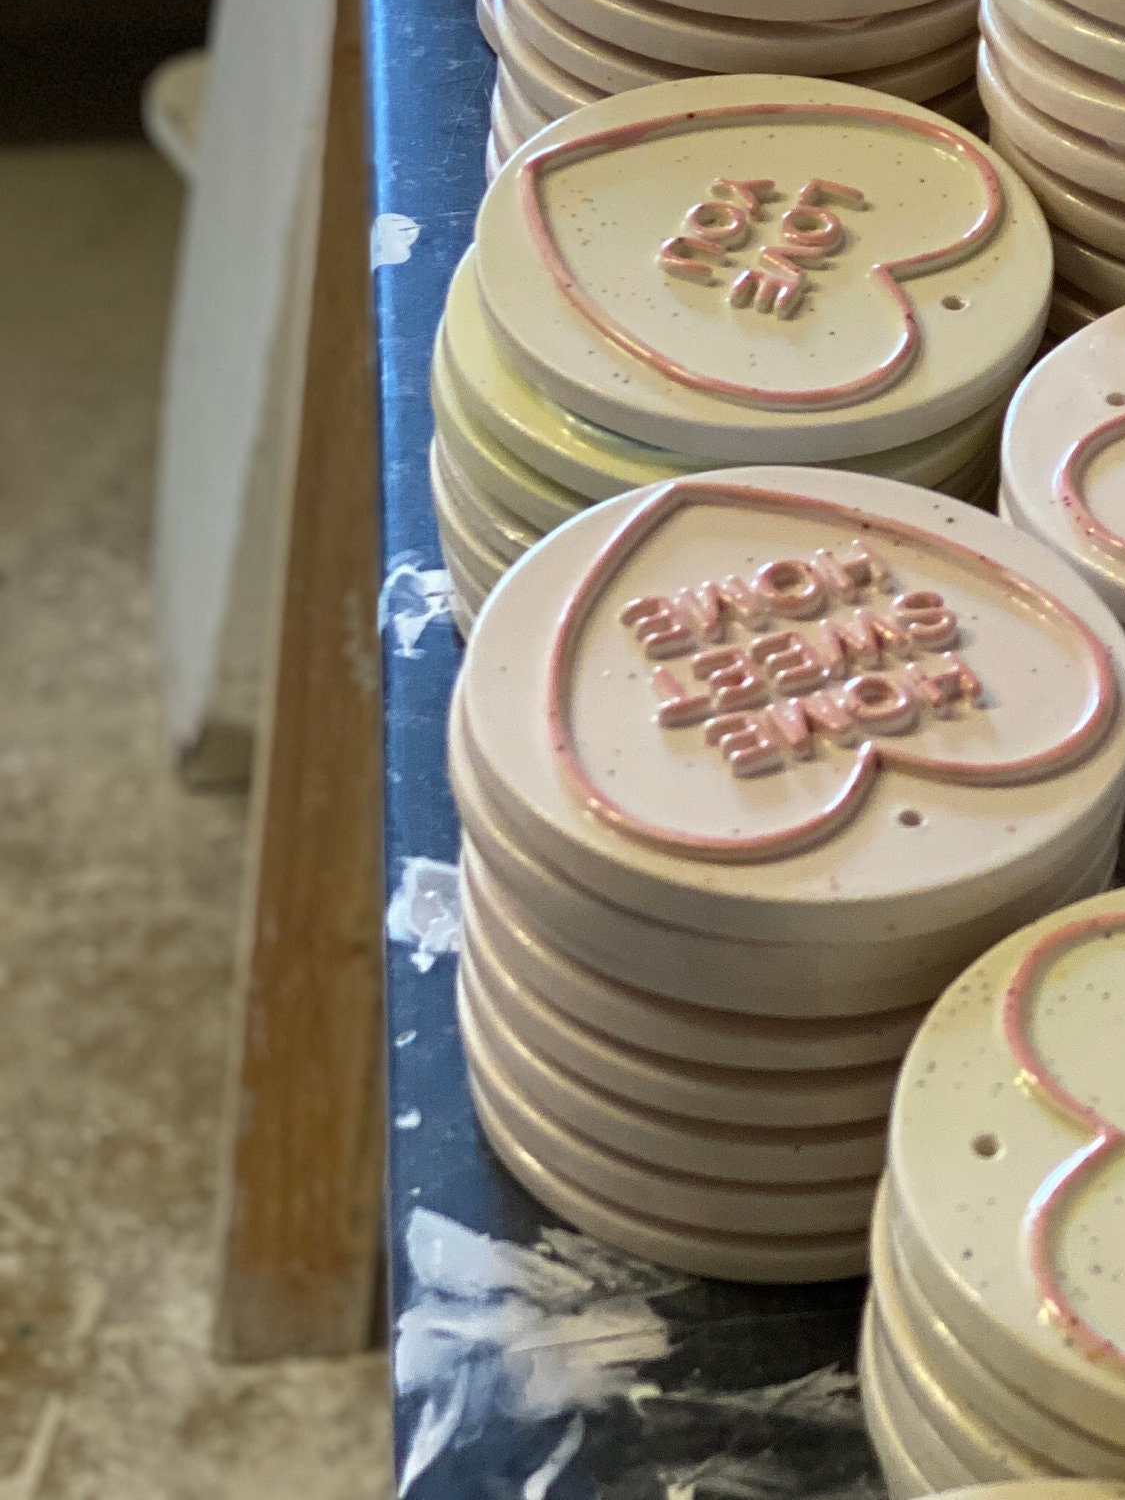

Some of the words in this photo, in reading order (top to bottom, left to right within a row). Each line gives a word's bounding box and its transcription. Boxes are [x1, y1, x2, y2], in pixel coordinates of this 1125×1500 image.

[655, 176, 776, 289] YOU
[726, 177, 870, 321] LOVE
[619, 538, 895, 662] HOME
[650, 588, 960, 730] SWEET
[700, 650, 985, 780] HOME
